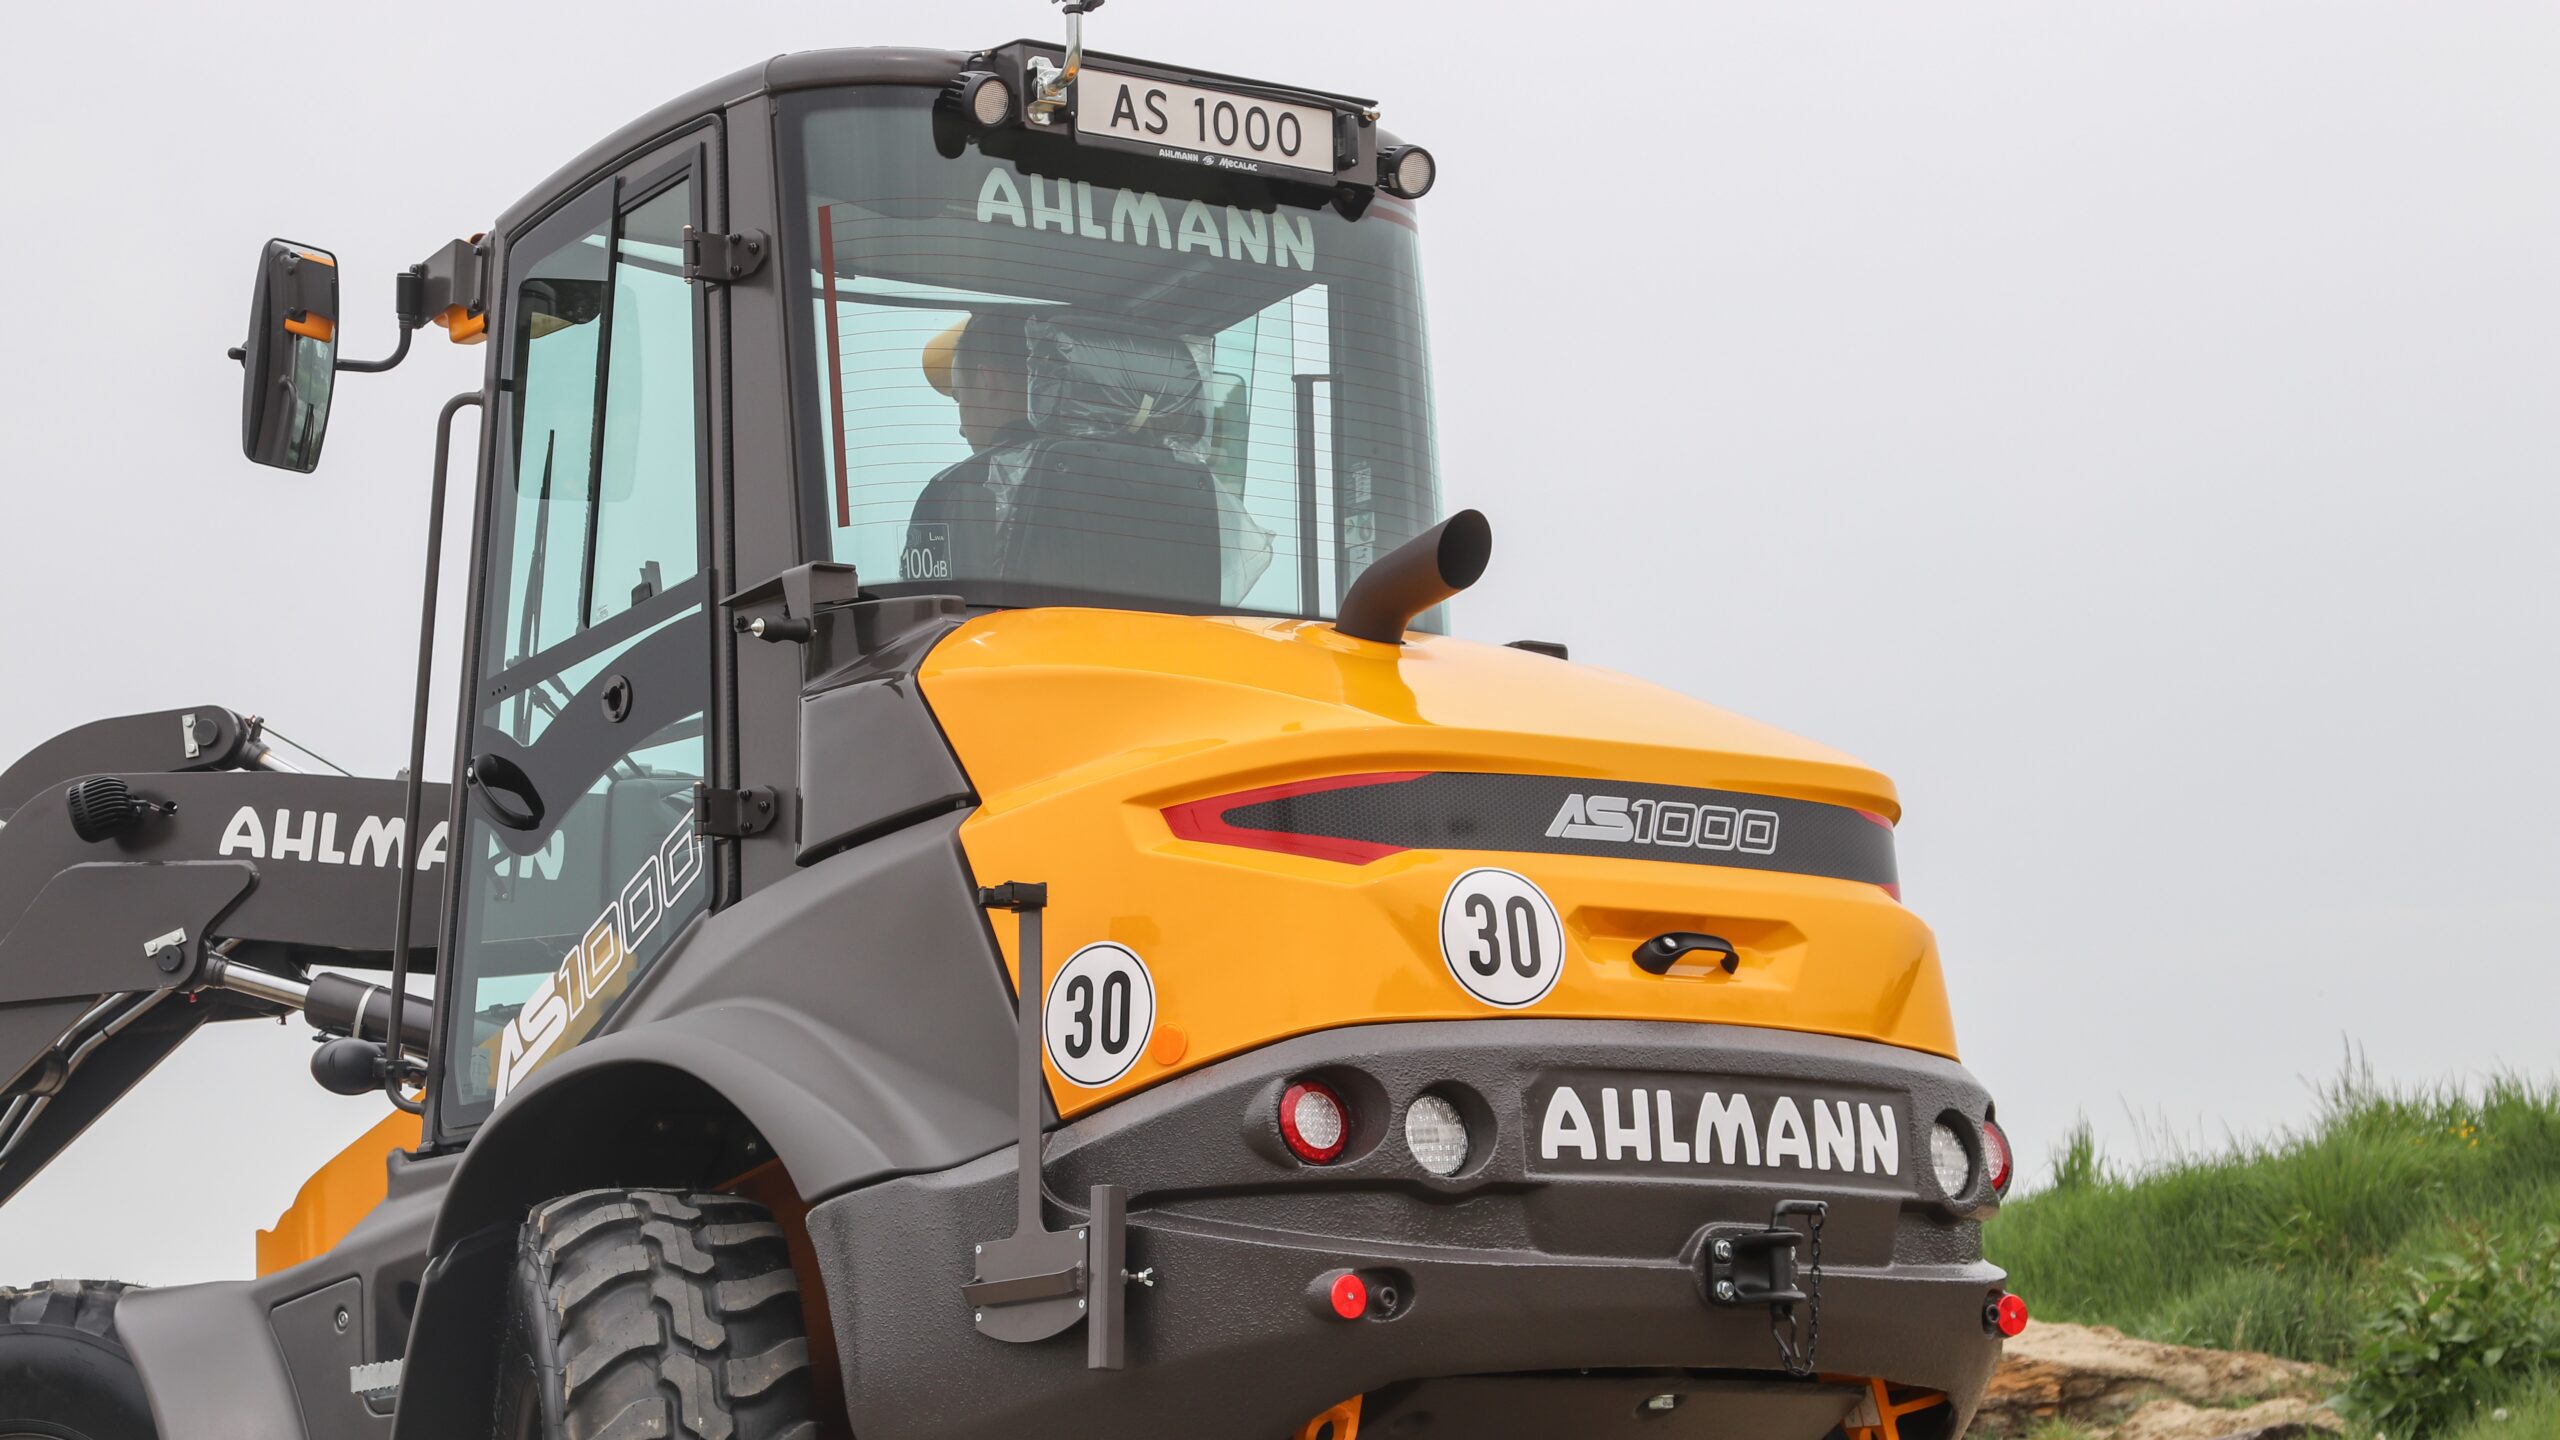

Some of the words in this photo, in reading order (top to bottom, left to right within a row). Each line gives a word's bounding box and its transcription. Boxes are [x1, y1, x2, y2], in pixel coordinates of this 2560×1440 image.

[1110, 83, 1168, 135] AS
[1194, 98, 1302, 157] 1000
[1159, 148, 1199, 162] AHLMANN
[977, 167, 1315, 271] AHLMANN
[1545, 793, 1780, 855] AS1000
[1464, 891, 1541, 979] 30
[1064, 971, 1133, 1060] 30
[1541, 1086, 1900, 1176] AHLMANN
